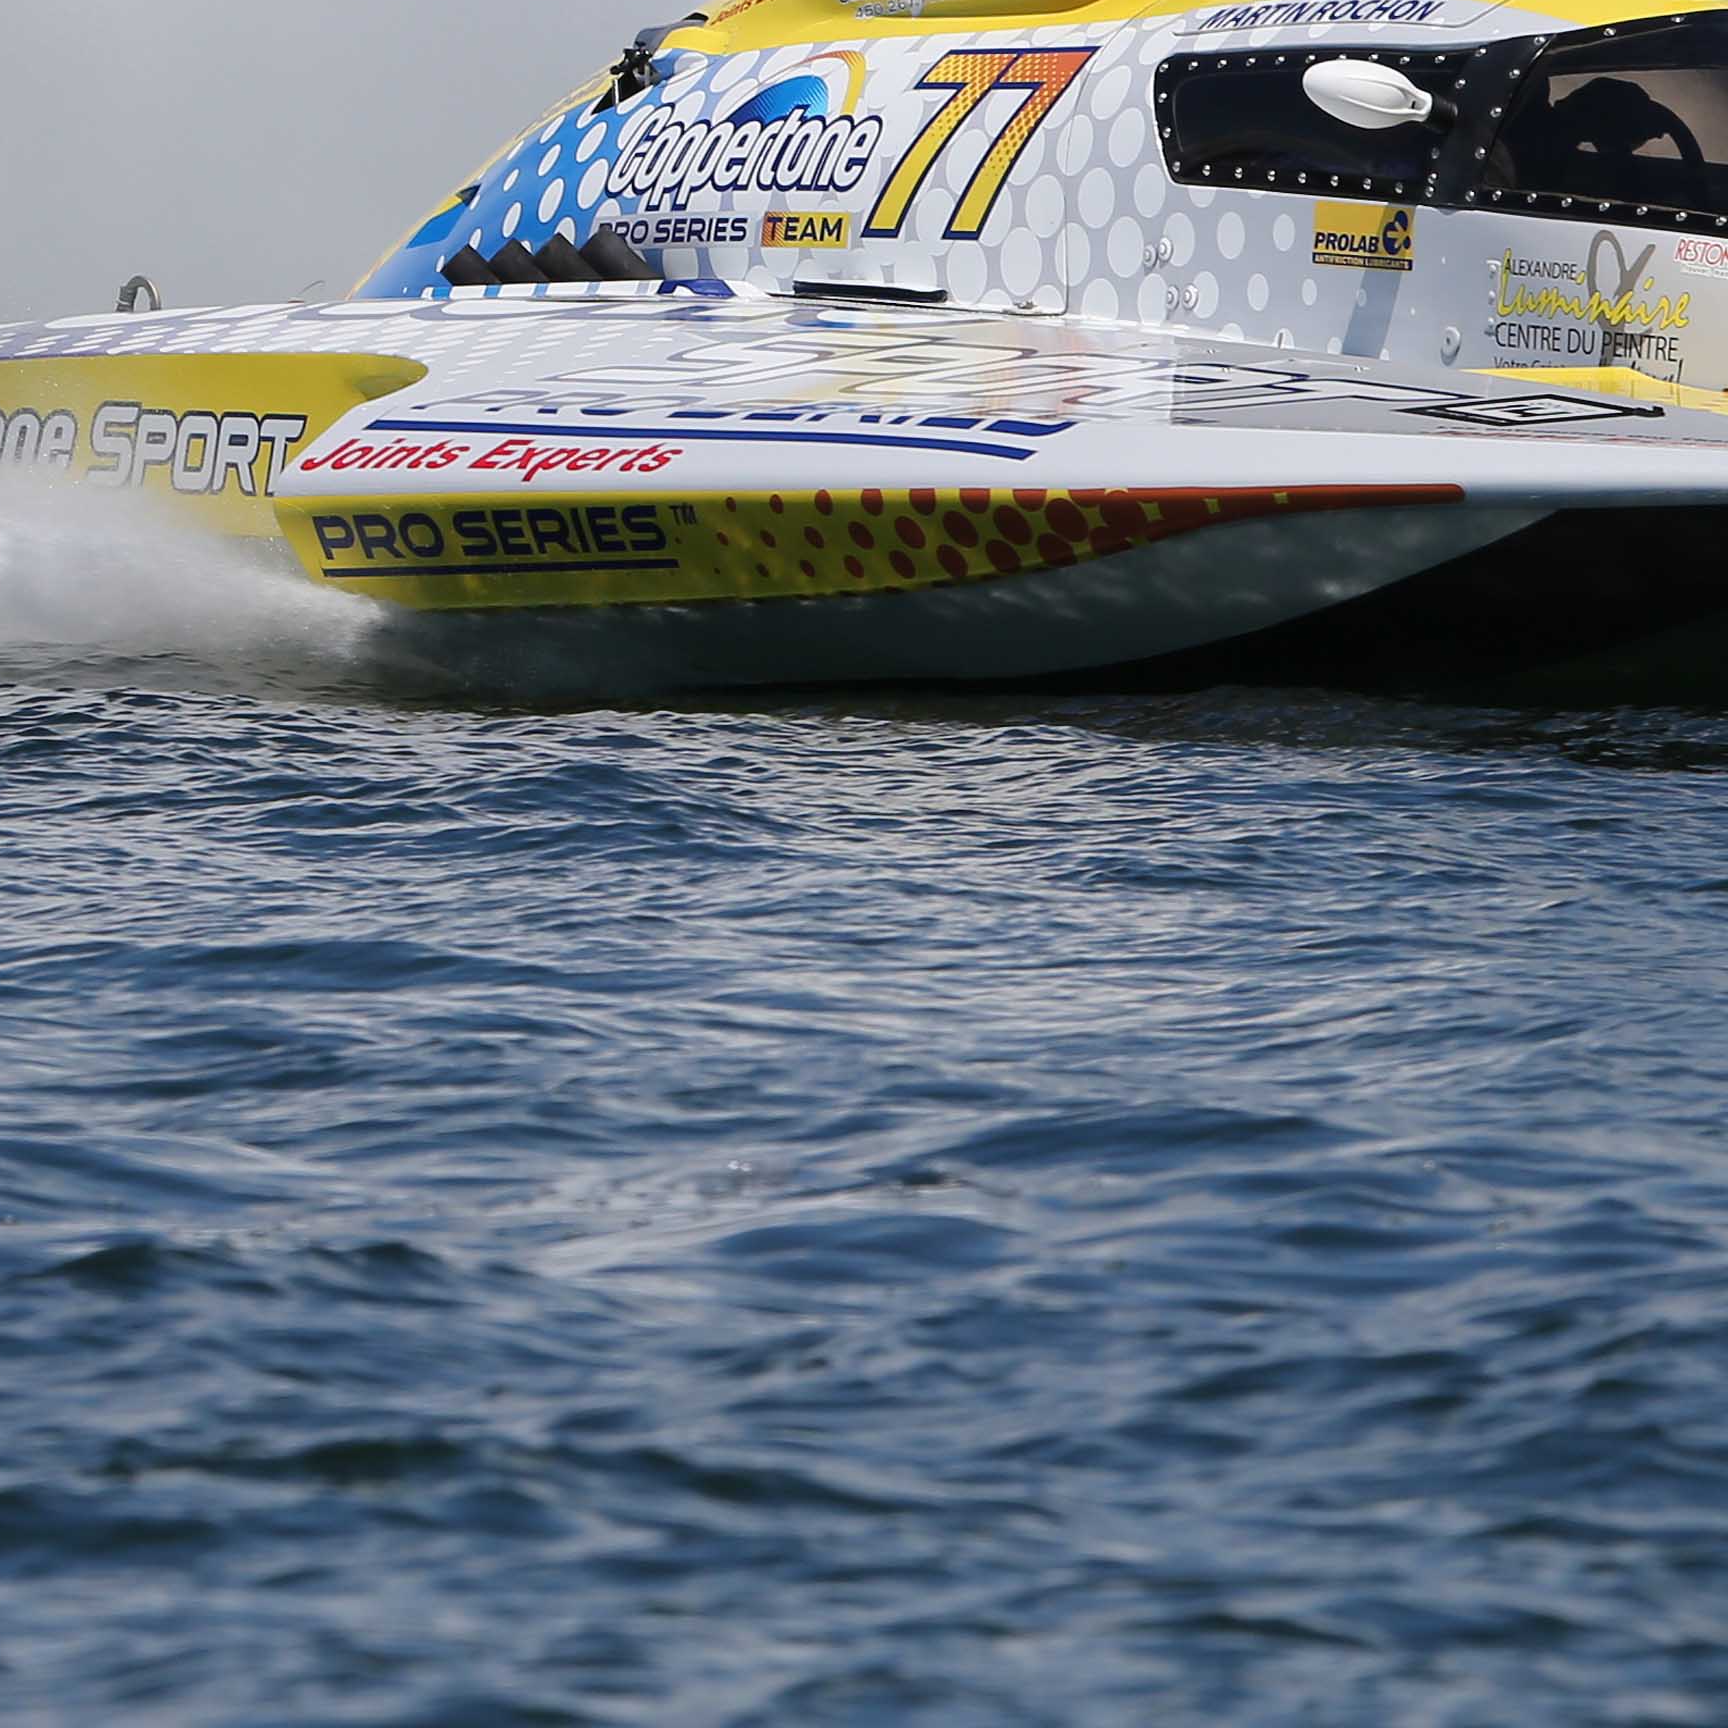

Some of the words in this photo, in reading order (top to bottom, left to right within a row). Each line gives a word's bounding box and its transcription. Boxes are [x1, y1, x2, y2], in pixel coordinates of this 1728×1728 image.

[1198, 2, 1315, 30] MARTIN
[1310, 0, 1445, 21] ROCHON
[605, 102, 884, 211] Coppertone
[861, 45, 1101, 241] 77
[653, 217, 749, 244] SERIES
[766, 216, 843, 243] TEAM
[1314, 232, 1380, 253] PROLAB
[1504, 257, 1578, 281] ALEXANDRE
[1494, 321, 1562, 353] CENTRE
[1566, 328, 1596, 355] DU
[1600, 331, 1680, 363] PEINTRE
[87, 400, 308, 497] SPORT
[299, 438, 471, 471] Joints
[467, 438, 684, 482] Experts
[312, 512, 445, 561] PRO
[452, 505, 667, 557] SERIES
